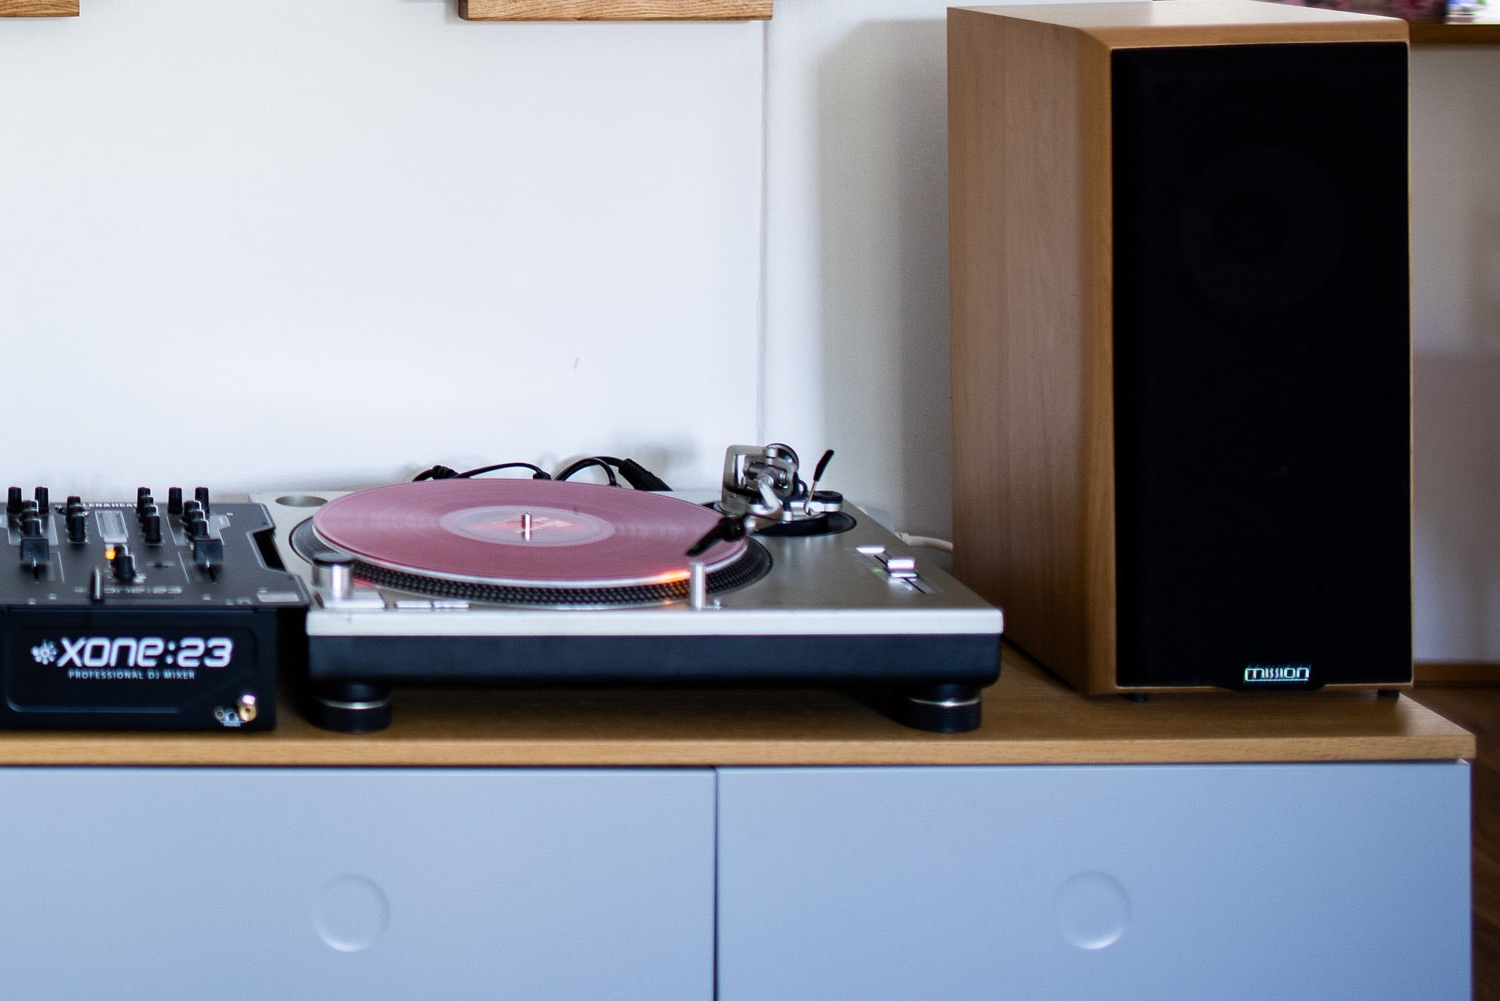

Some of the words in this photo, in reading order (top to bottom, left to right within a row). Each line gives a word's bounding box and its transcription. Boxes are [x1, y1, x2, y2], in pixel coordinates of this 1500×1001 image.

[68, 670, 144, 680] PROFESSIONAL
[148, 670, 160, 680] DJ
[164, 670, 195, 680] MIXER
